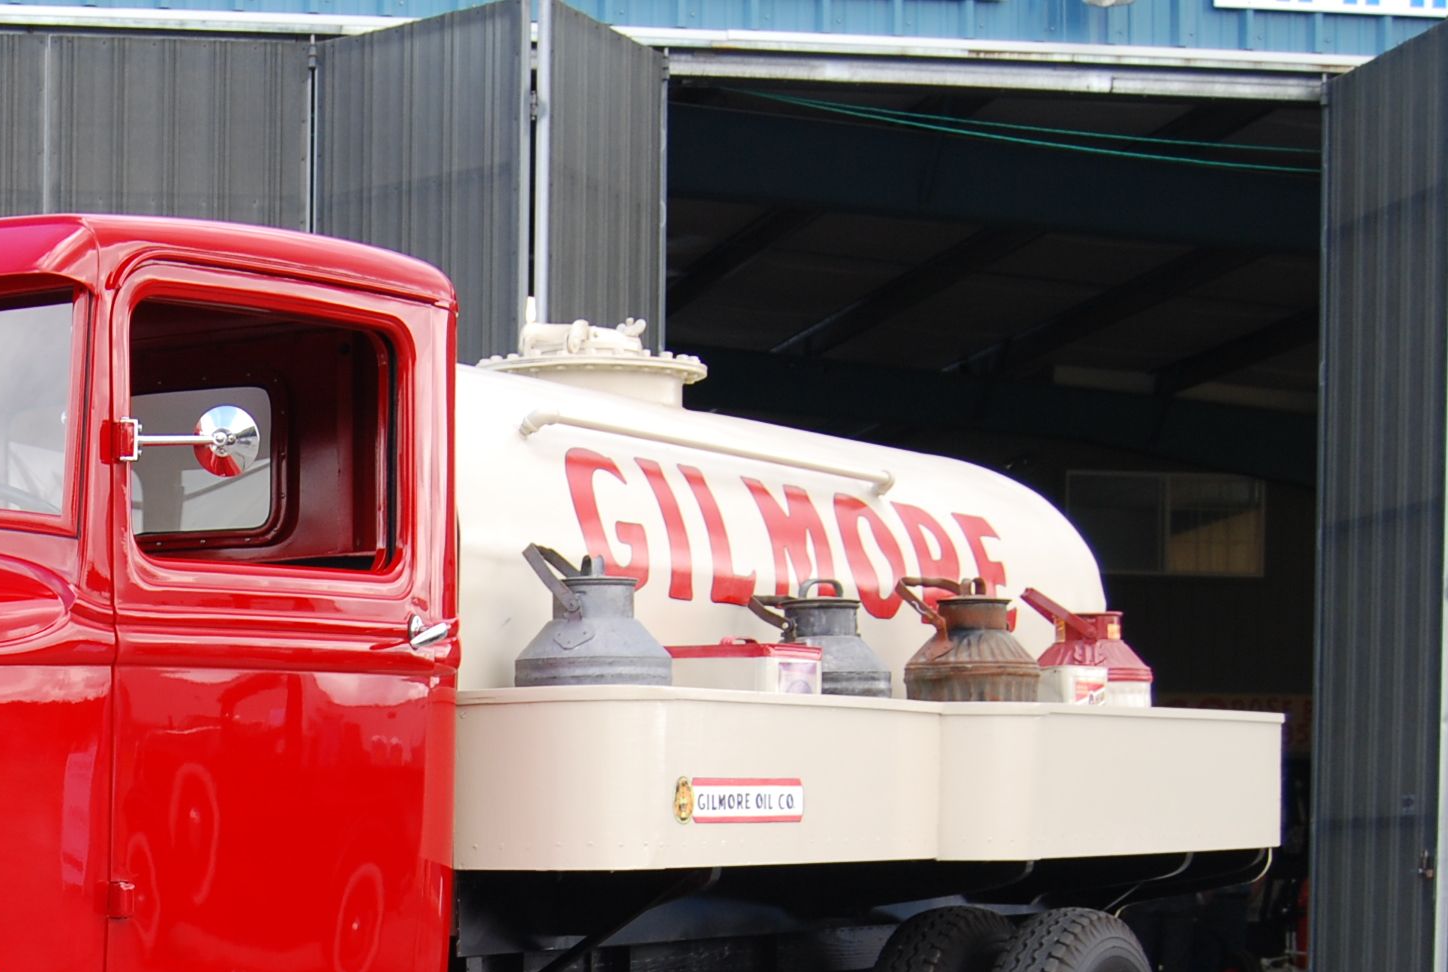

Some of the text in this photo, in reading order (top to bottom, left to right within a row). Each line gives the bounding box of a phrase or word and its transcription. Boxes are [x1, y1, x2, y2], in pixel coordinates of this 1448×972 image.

[565, 447, 1017, 632] GILMORE
[697, 793, 751, 810] GILMORE
[755, 793, 773, 810] OIL
